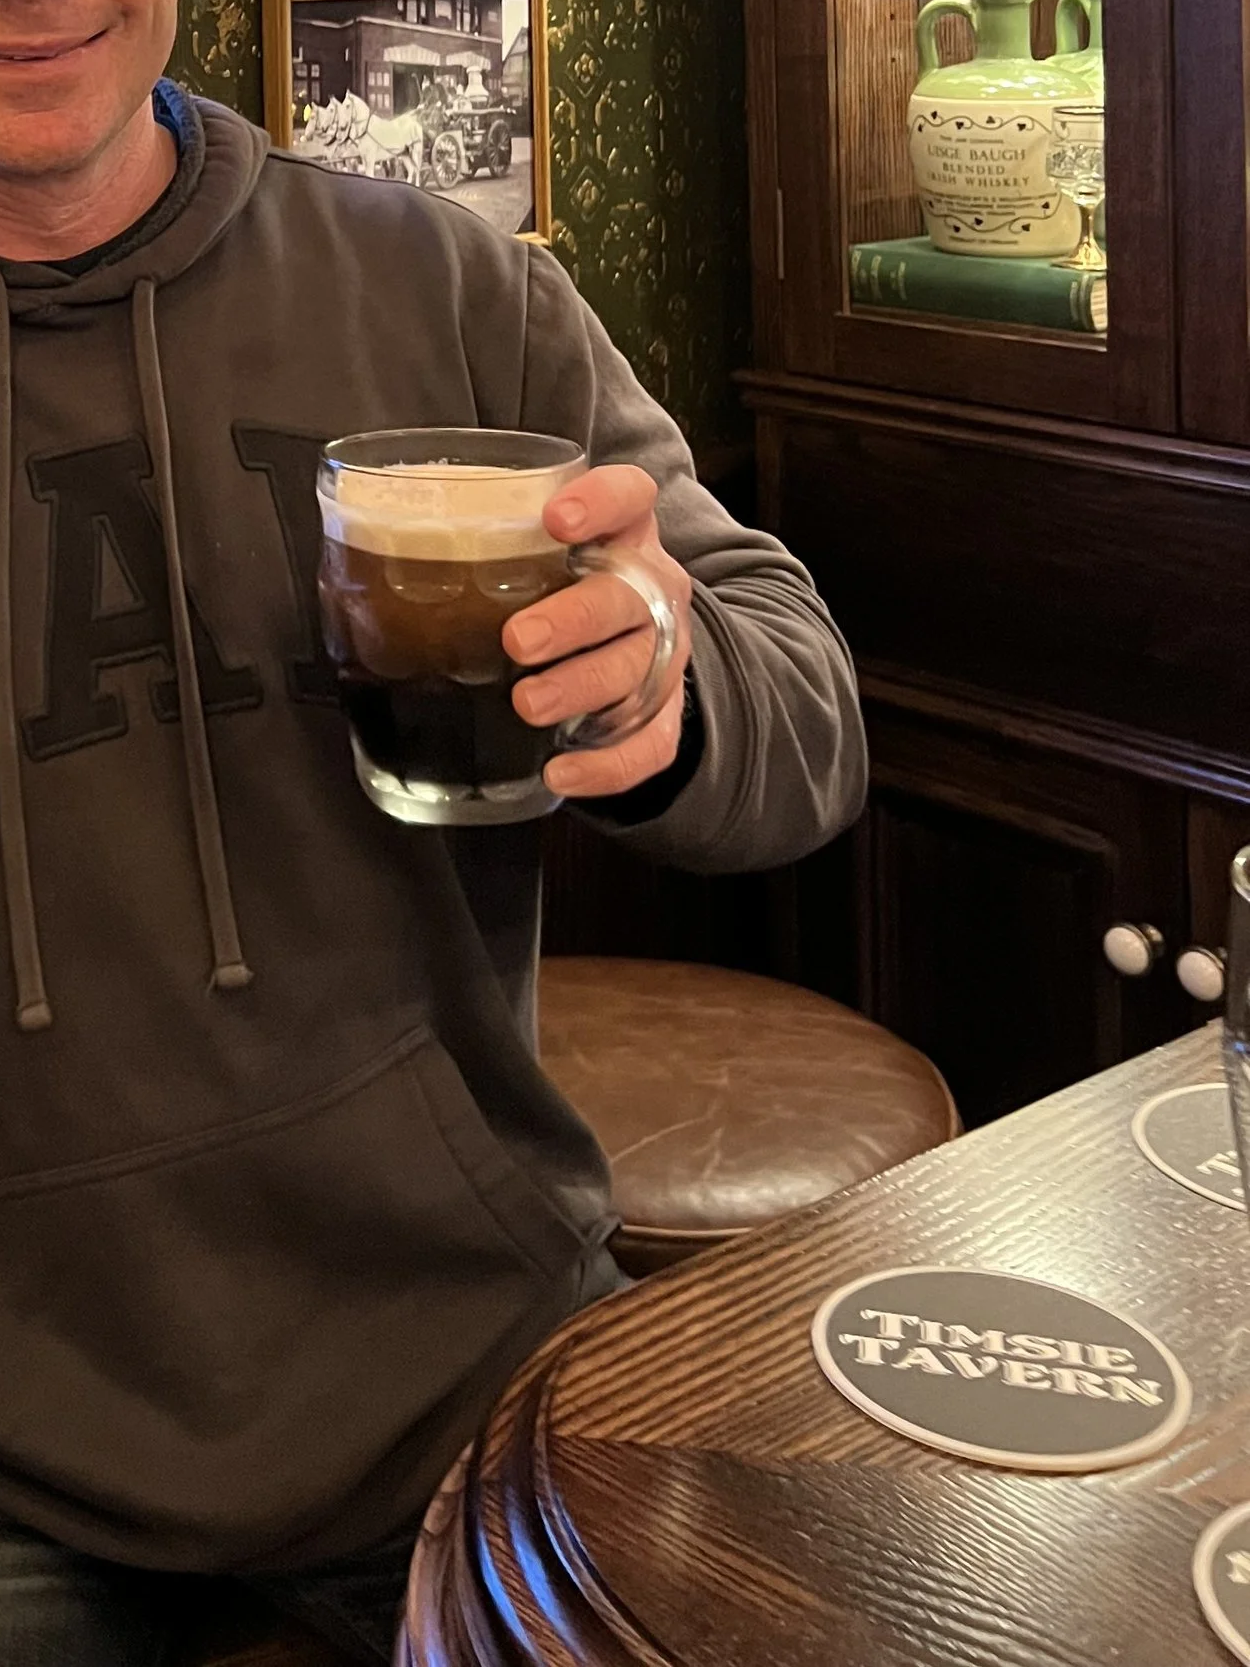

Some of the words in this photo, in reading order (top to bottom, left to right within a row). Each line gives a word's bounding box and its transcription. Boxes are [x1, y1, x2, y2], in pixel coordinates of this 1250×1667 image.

[969, 148, 1026, 162] BAUGH
[942, 161, 1006, 175] BLENDED
[965, 176, 1030, 187] WHISKEY
[860, 1308, 1138, 1374] TIMSIE
[838, 1333, 1164, 1408] TAVERN
